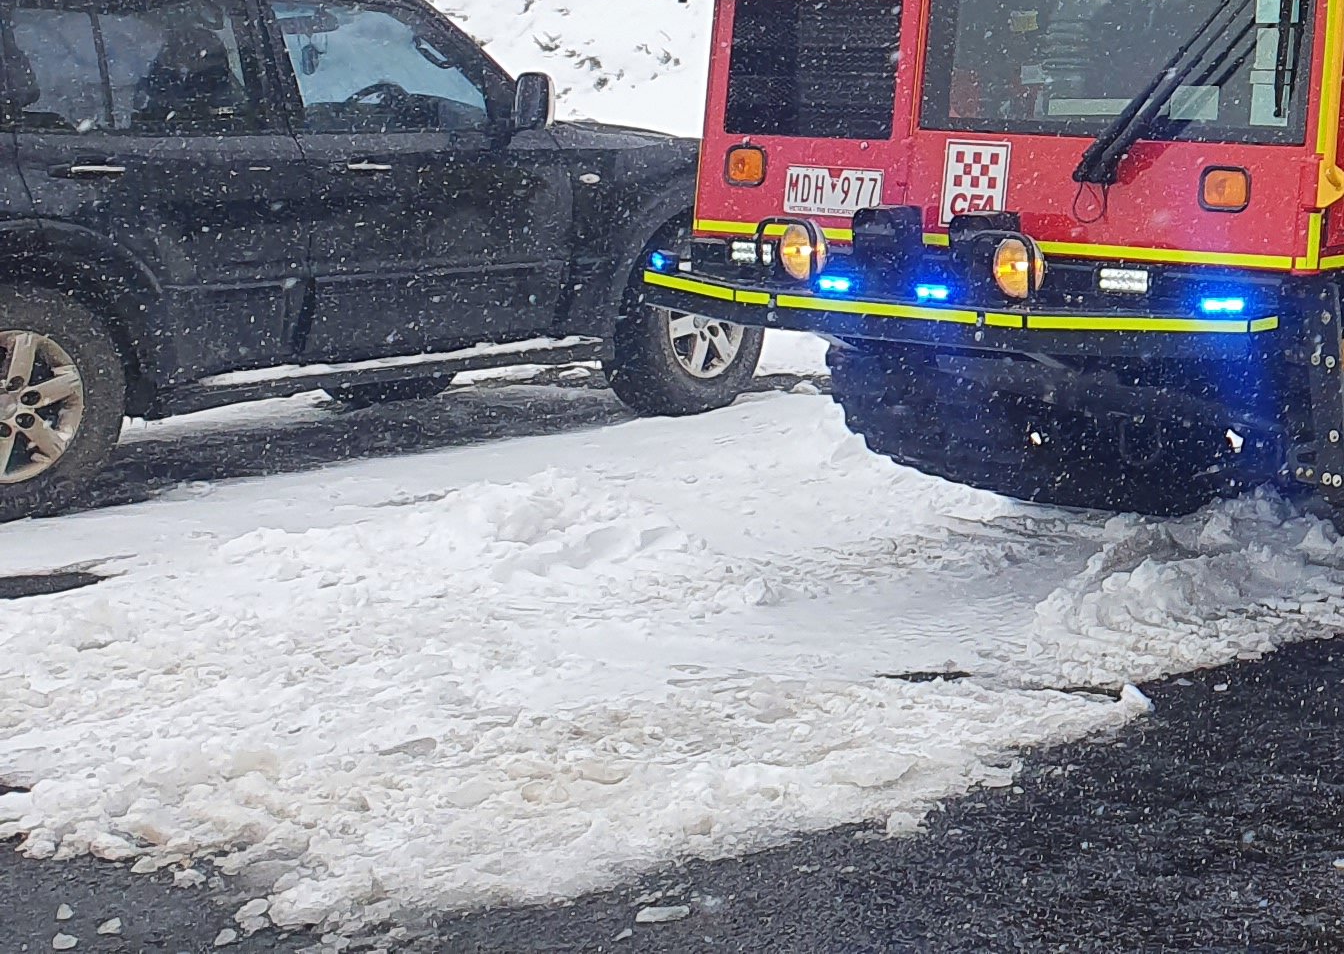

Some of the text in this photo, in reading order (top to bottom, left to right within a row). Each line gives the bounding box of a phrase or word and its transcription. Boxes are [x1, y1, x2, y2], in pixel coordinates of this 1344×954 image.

[787, 172, 878, 208] MDH 977
[950, 192, 995, 215] CFA
